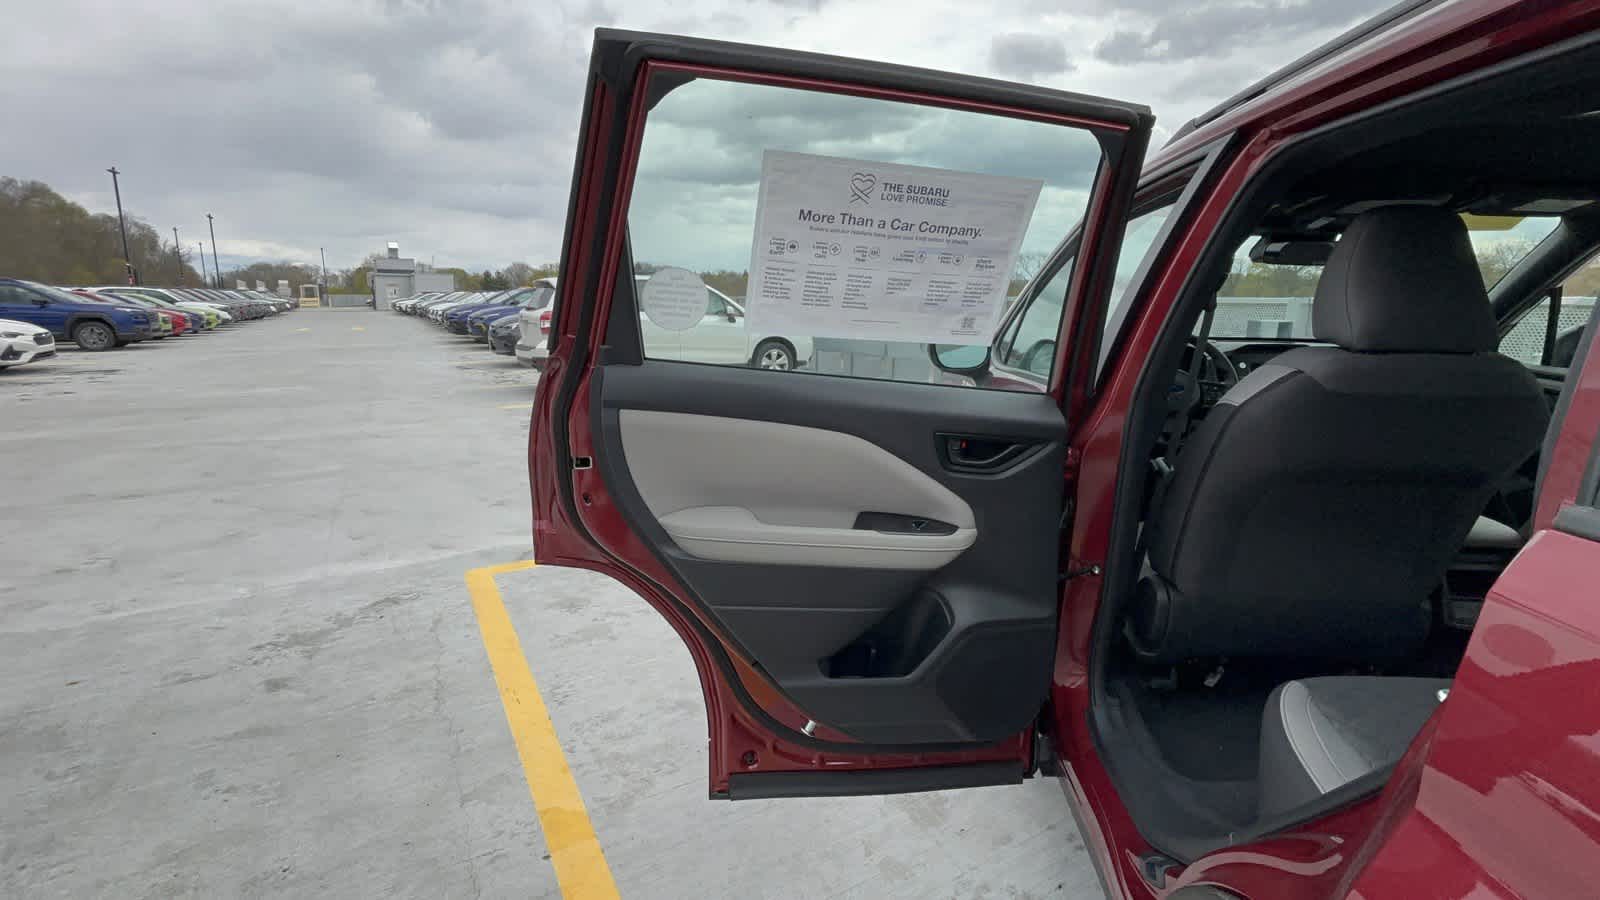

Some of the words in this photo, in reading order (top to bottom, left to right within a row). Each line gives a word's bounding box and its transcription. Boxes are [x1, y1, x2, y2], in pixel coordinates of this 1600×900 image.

[881, 182, 904, 194] THE
[906, 184, 950, 198] SUBARU
[880, 193, 905, 203] LOVE
[906, 195, 949, 207] PROMISE
[798, 208, 836, 224] More
[840, 212, 874, 228] Than
[877, 220, 887, 230] a
[890, 218, 916, 232] Car
[918, 221, 983, 240] Company.
